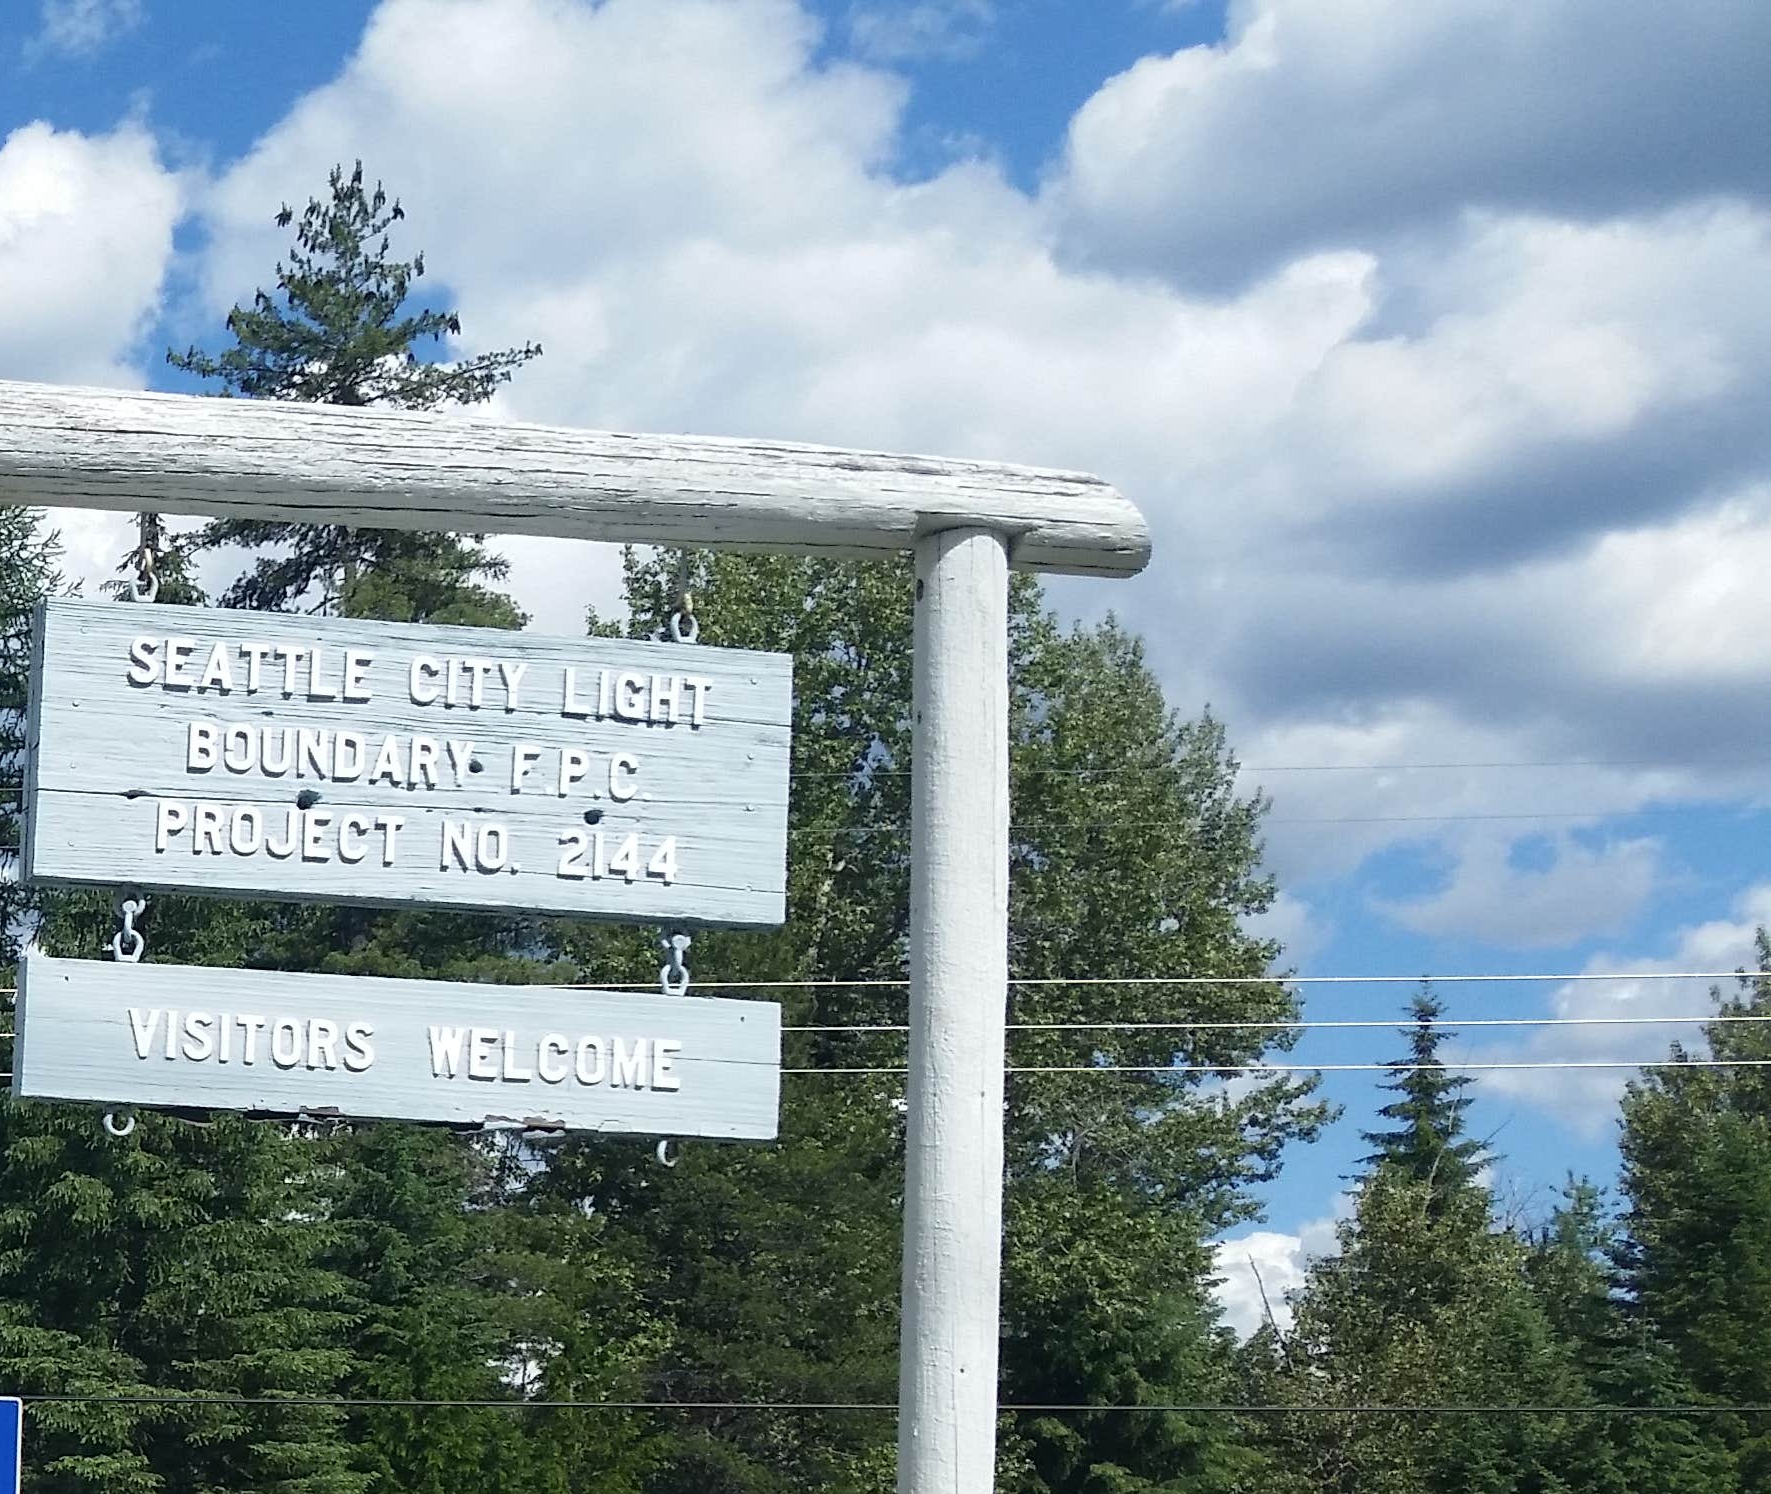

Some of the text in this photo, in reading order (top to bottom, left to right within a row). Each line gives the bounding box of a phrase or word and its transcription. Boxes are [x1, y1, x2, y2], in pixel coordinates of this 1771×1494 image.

[127, 636, 713, 727] SEATTLE CITY LIGHT
[186, 721, 651, 802] BOUNDARY F.P.C.
[155, 801, 679, 885] PROJECT NO. 2144
[127, 1008, 682, 1091] VISITORS WELCOME
